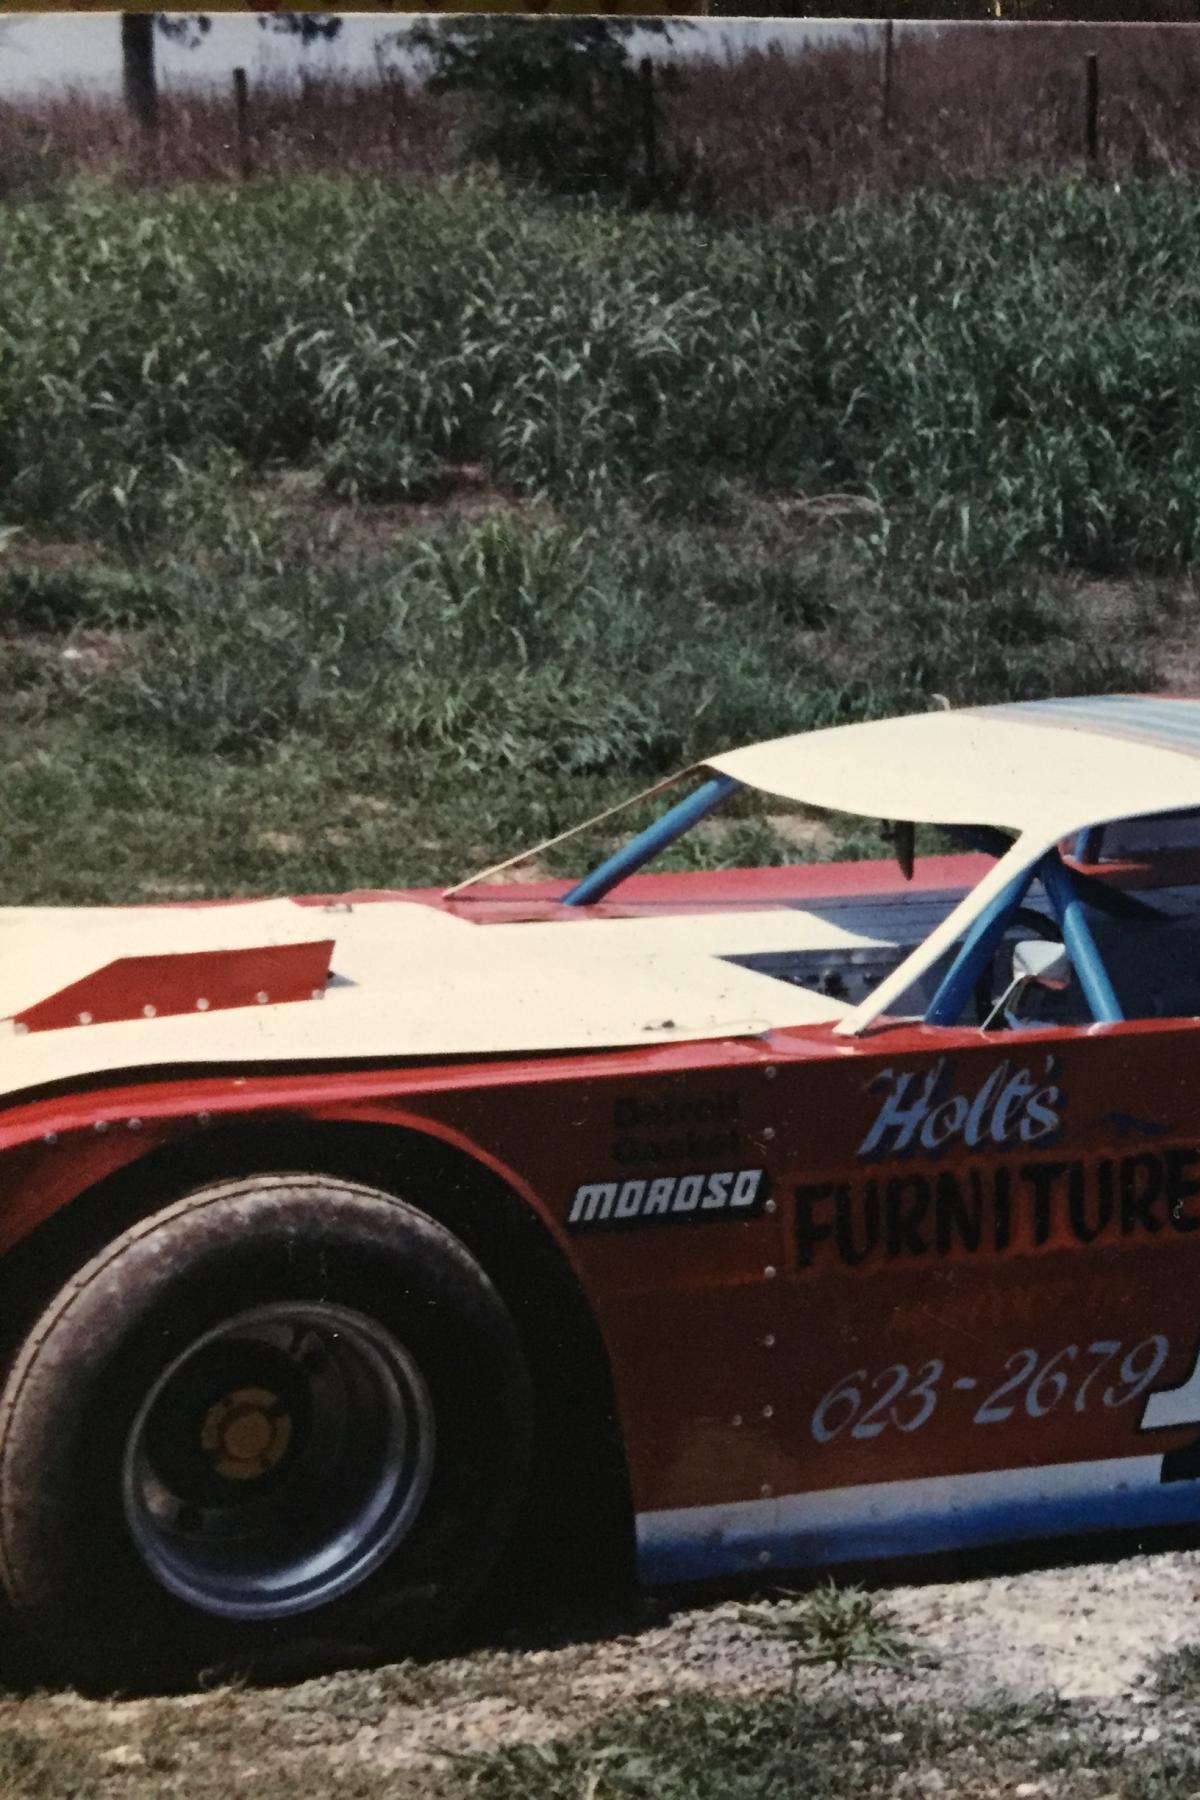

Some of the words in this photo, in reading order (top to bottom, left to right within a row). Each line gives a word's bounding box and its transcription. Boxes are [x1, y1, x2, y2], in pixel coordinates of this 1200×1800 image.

[857, 1054, 1065, 1160] Holt's
[568, 1168, 763, 1222] MOROSO
[811, 1334, 1169, 1443] 623-2679
